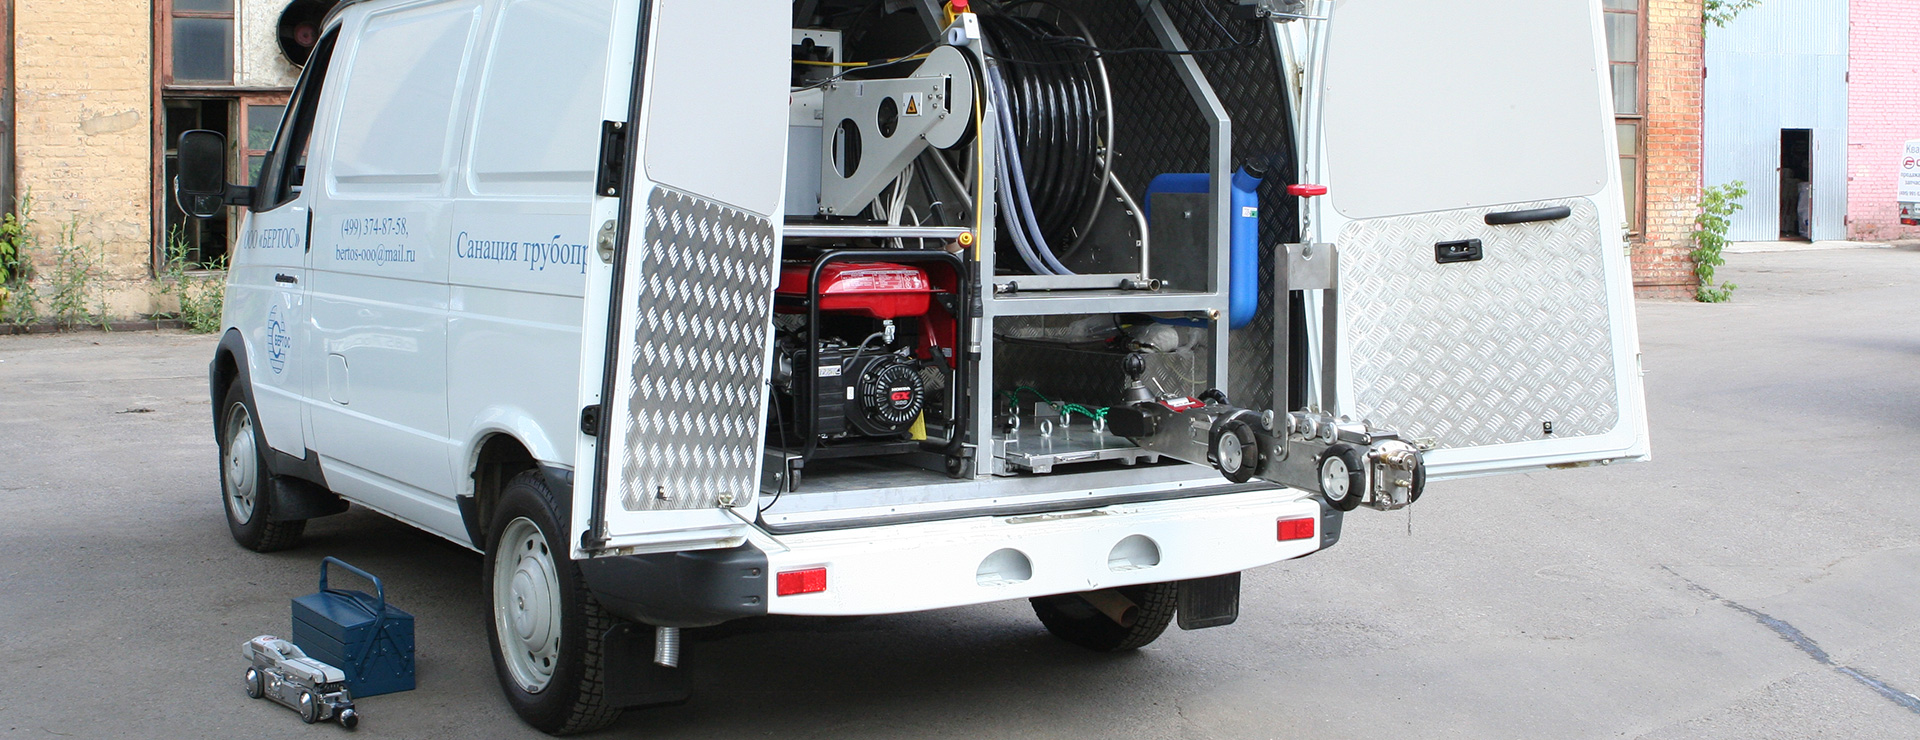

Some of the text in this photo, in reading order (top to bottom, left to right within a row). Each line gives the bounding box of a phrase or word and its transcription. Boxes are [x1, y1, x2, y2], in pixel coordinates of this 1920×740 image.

[259, 227, 300, 249] «БЕРТОС»
[341, 217, 409, 239] (499) 374-87-58,
[335, 243, 416, 267] bertos-ooo@mail.ru
[456, 231, 518, 263] Санация
[274, 334, 291, 349] БЕРТОС
[891, 391, 911, 401] GX
